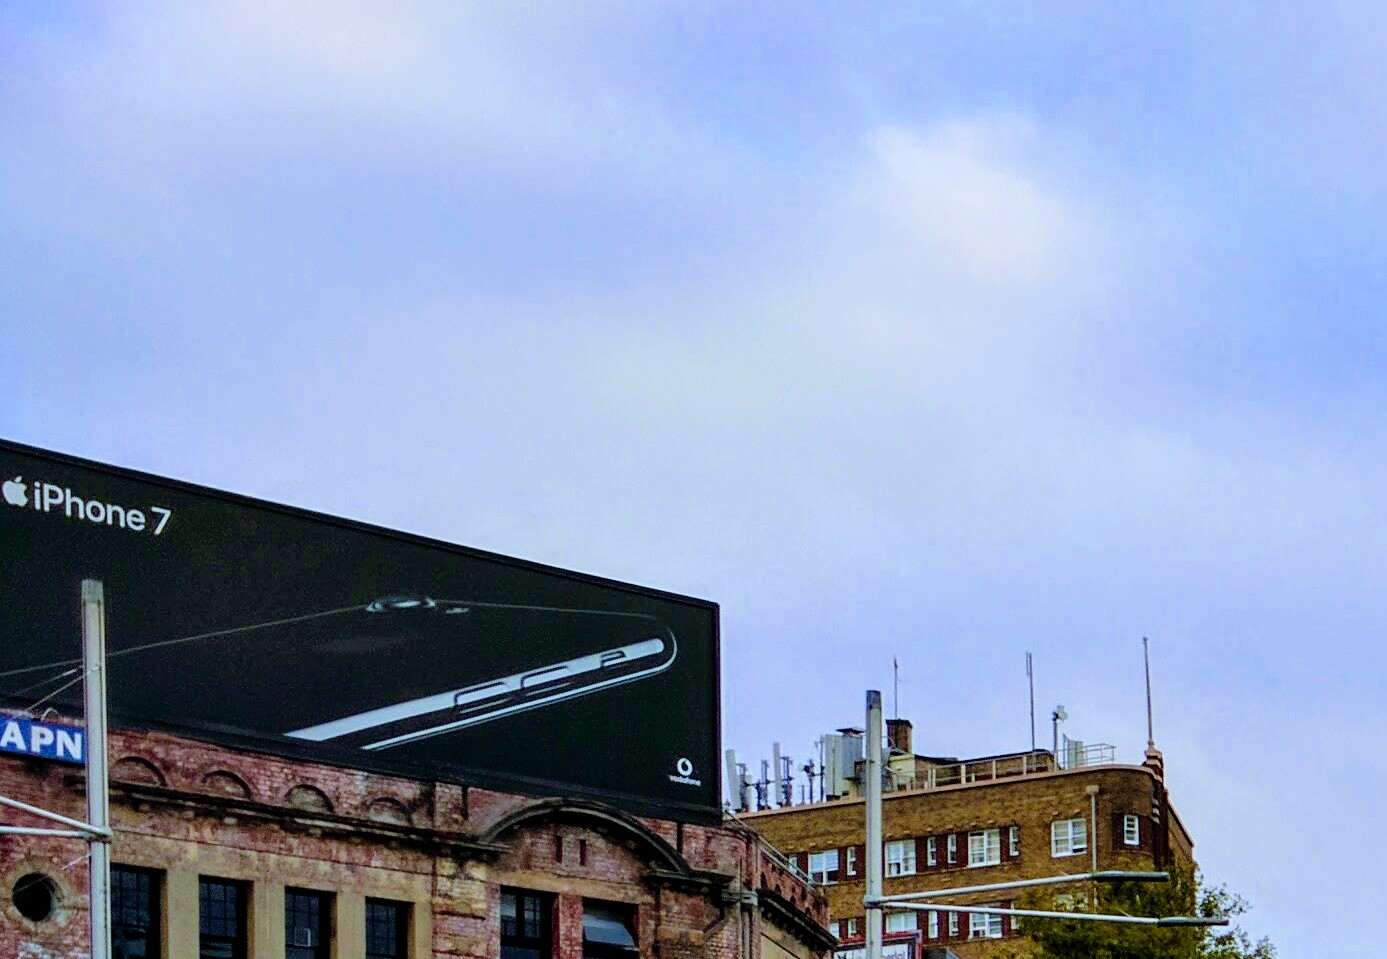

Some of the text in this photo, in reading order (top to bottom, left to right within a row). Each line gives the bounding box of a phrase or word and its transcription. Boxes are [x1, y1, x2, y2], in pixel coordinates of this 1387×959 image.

[34, 481, 172, 536] iPhone 7
[0, 721, 83, 760] APN
